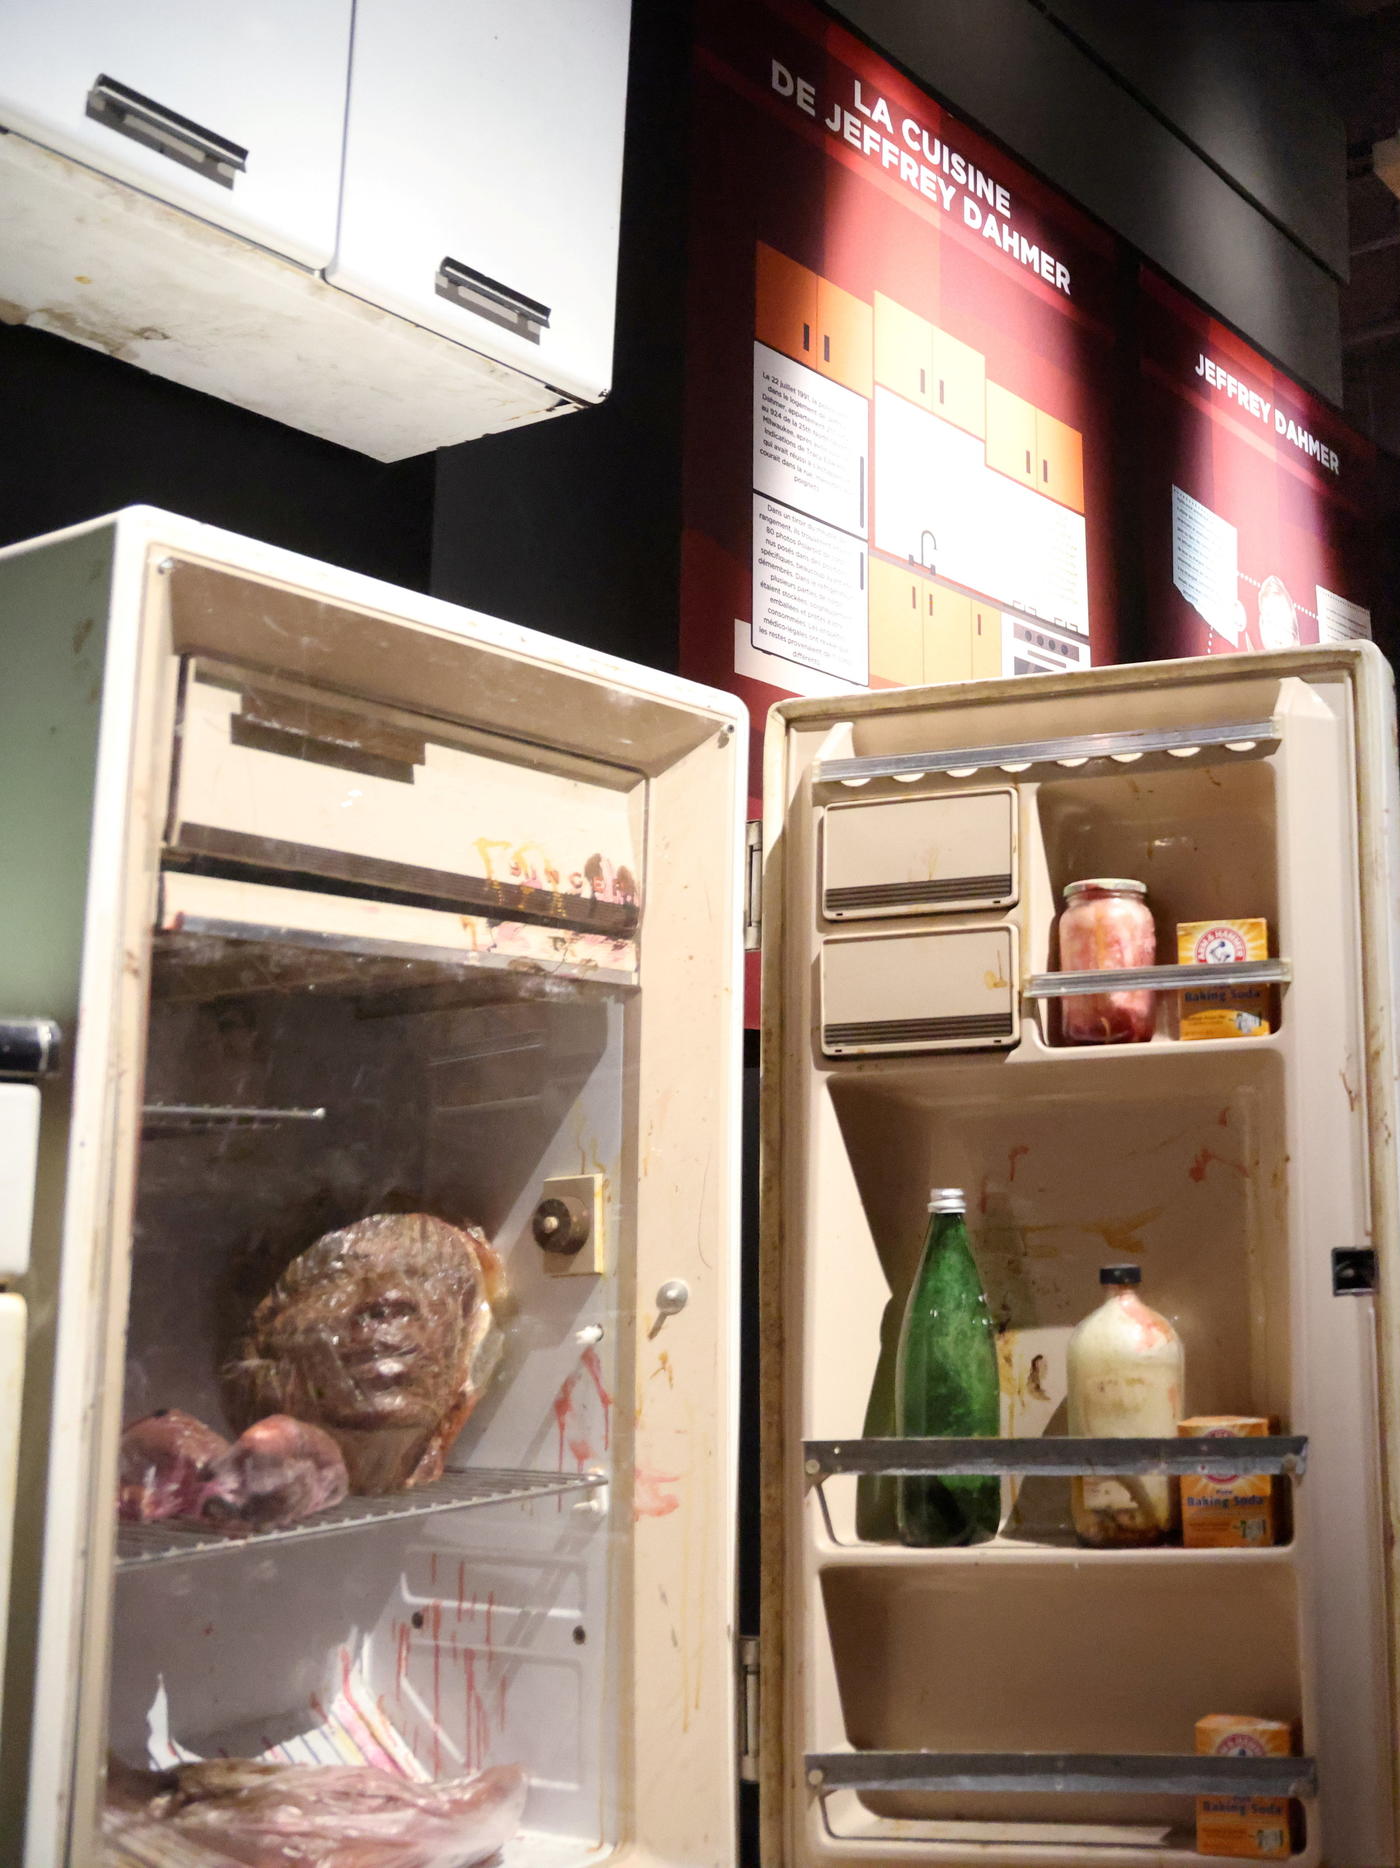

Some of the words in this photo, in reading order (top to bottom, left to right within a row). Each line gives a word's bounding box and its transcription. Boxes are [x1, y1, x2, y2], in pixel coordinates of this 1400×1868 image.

[854, 79, 894, 135] LA
[901, 117, 1011, 219] CUISINE
[771, 58, 816, 118] DE
[824, 103, 956, 212] JEFFREY
[962, 195, 1072, 296] DAHMER
[771, 376, 779, 385] 22
[780, 380, 796, 394] juillet
[768, 386, 782, 398] dans
[790, 396, 817, 416] logement
[770, 408, 782, 420] 924
[783, 414, 791, 424] de
[792, 419, 798, 427] la
[1195, 353, 1271, 424] JEFFREY
[1274, 408, 1340, 476] DAHMER
[763, 439, 773, 449] qui
[774, 443, 789, 456] avait
[760, 448, 781, 463] courait
[782, 459, 796, 471] dans
[767, 504, 782, 517] Dans
[783, 512, 791, 520] un
[759, 513, 793, 534] rangement,
[766, 526, 775, 535] 80
[775, 531, 796, 545] photos
[765, 539, 776, 548] nus
[777, 543, 794, 556] posés
[760, 581, 781, 595] étaient
[770, 575, 796, 591] plusieurs
[769, 597, 799, 613] emballées
[759, 626, 768, 635] les
[769, 630, 787, 643] restes
[763, 617, 808, 639] médico-légales
[1184, 990, 1226, 1002] Baking
[1231, 989, 1261, 1000] Soda
[1187, 1496, 1230, 1510] Baking
[1234, 1495, 1265, 1506] Soda
[1203, 1801, 1247, 1816] Baking
[1251, 1803, 1283, 1816] Soda
